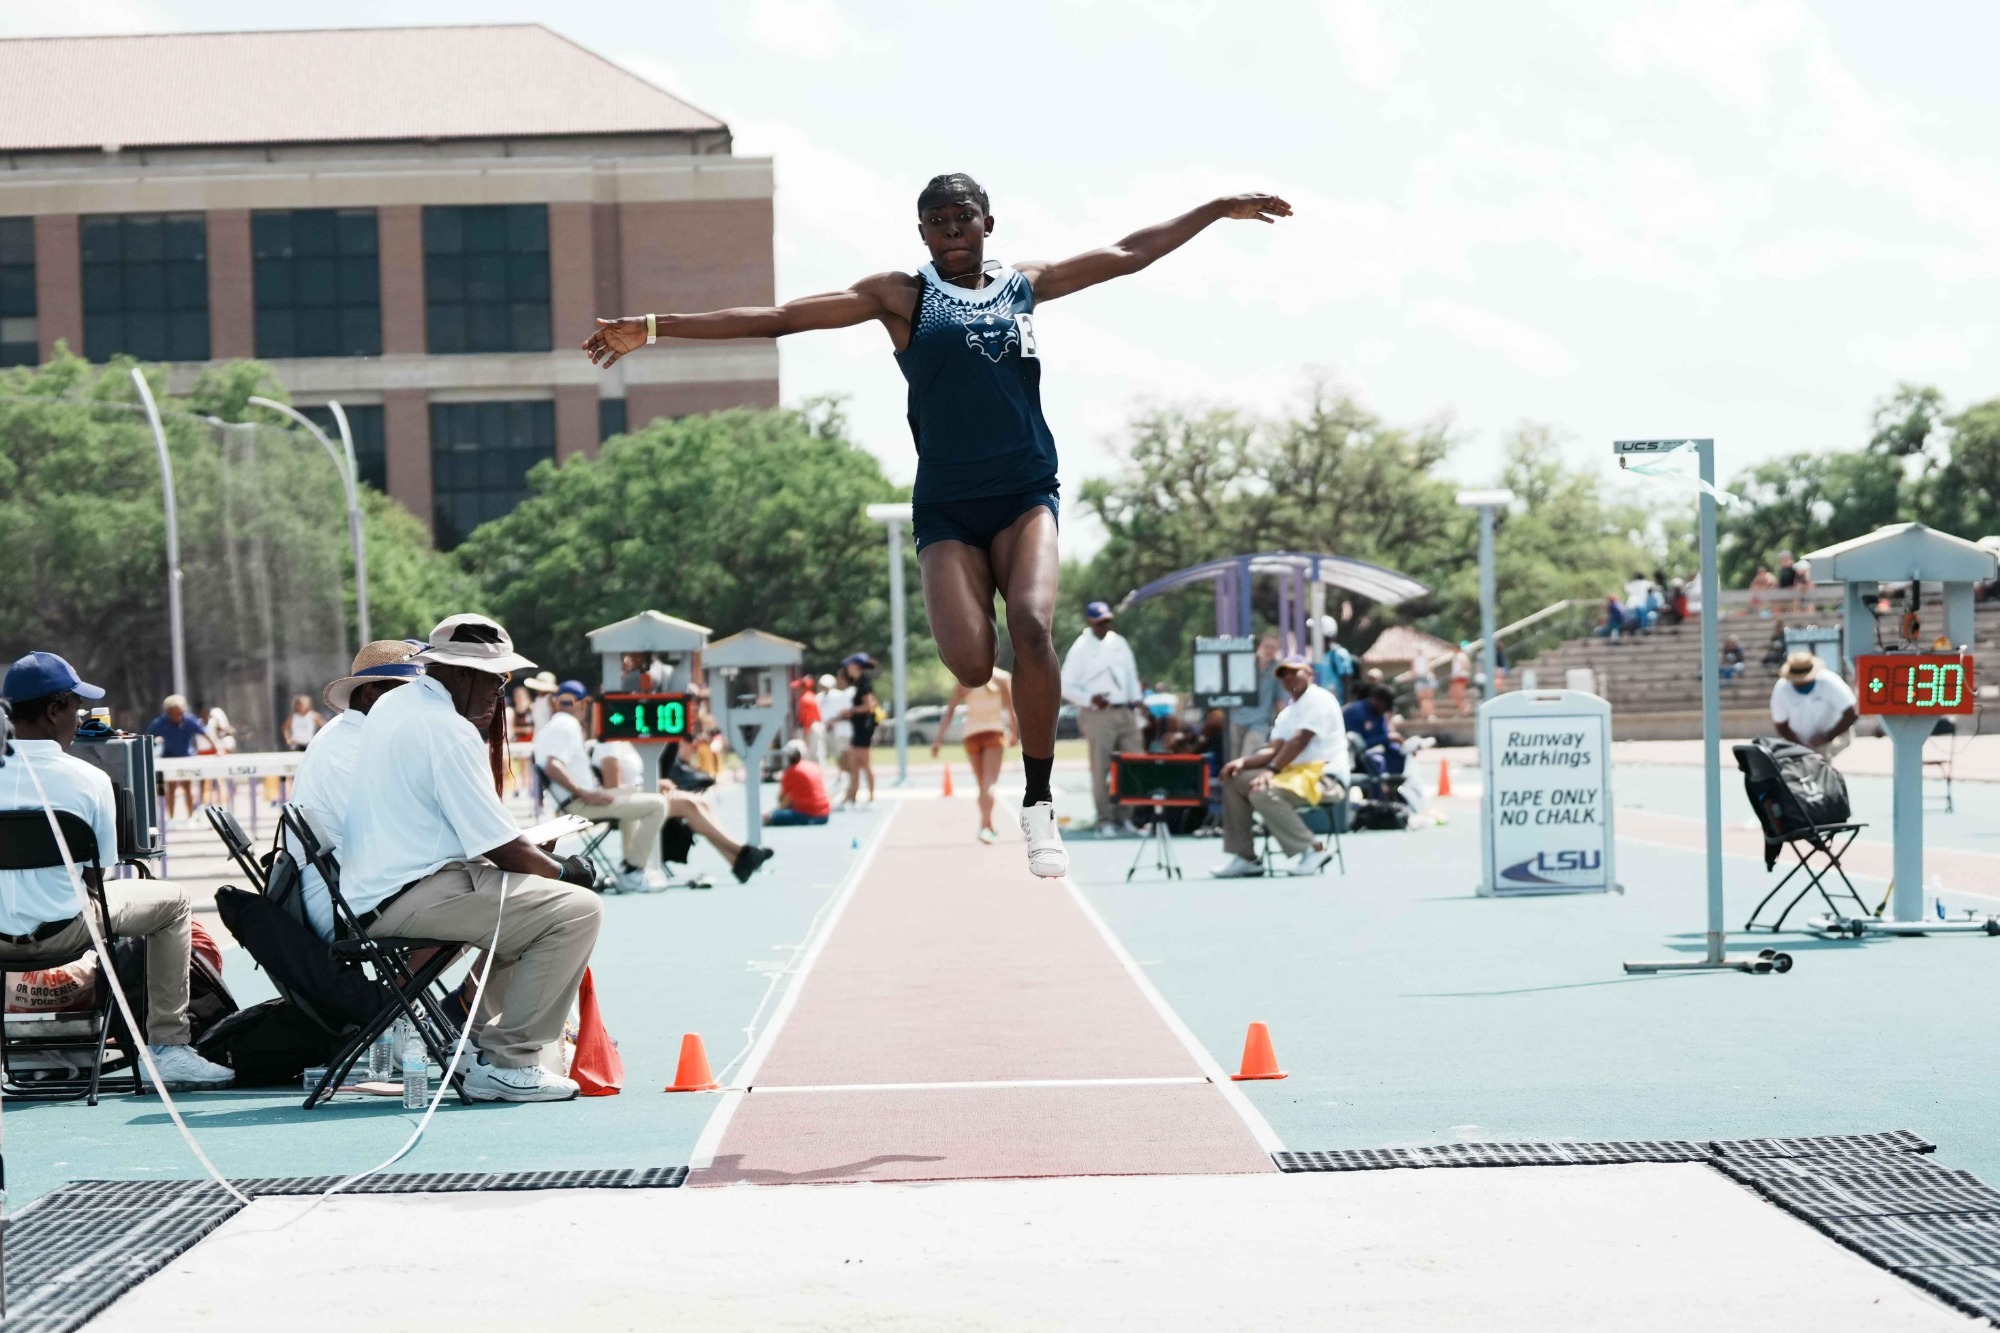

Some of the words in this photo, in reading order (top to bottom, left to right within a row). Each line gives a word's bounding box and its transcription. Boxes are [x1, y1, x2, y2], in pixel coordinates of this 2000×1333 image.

[1622, 441, 1659, 451] UCS
[1508, 731, 1585, 748] Runway
[1501, 750, 1591, 768] Markings
[228, 766, 257, 775] LSU
[1500, 790, 1543, 806] TAPE
[1550, 788, 1597, 805] ONLY
[1500, 810, 1528, 826] NO
[1535, 808, 1595, 825] CHALK
[1538, 850, 1601, 871] LSU
[16, 983, 28, 994] OR
[30, 980, 79, 997] GROCERIES
